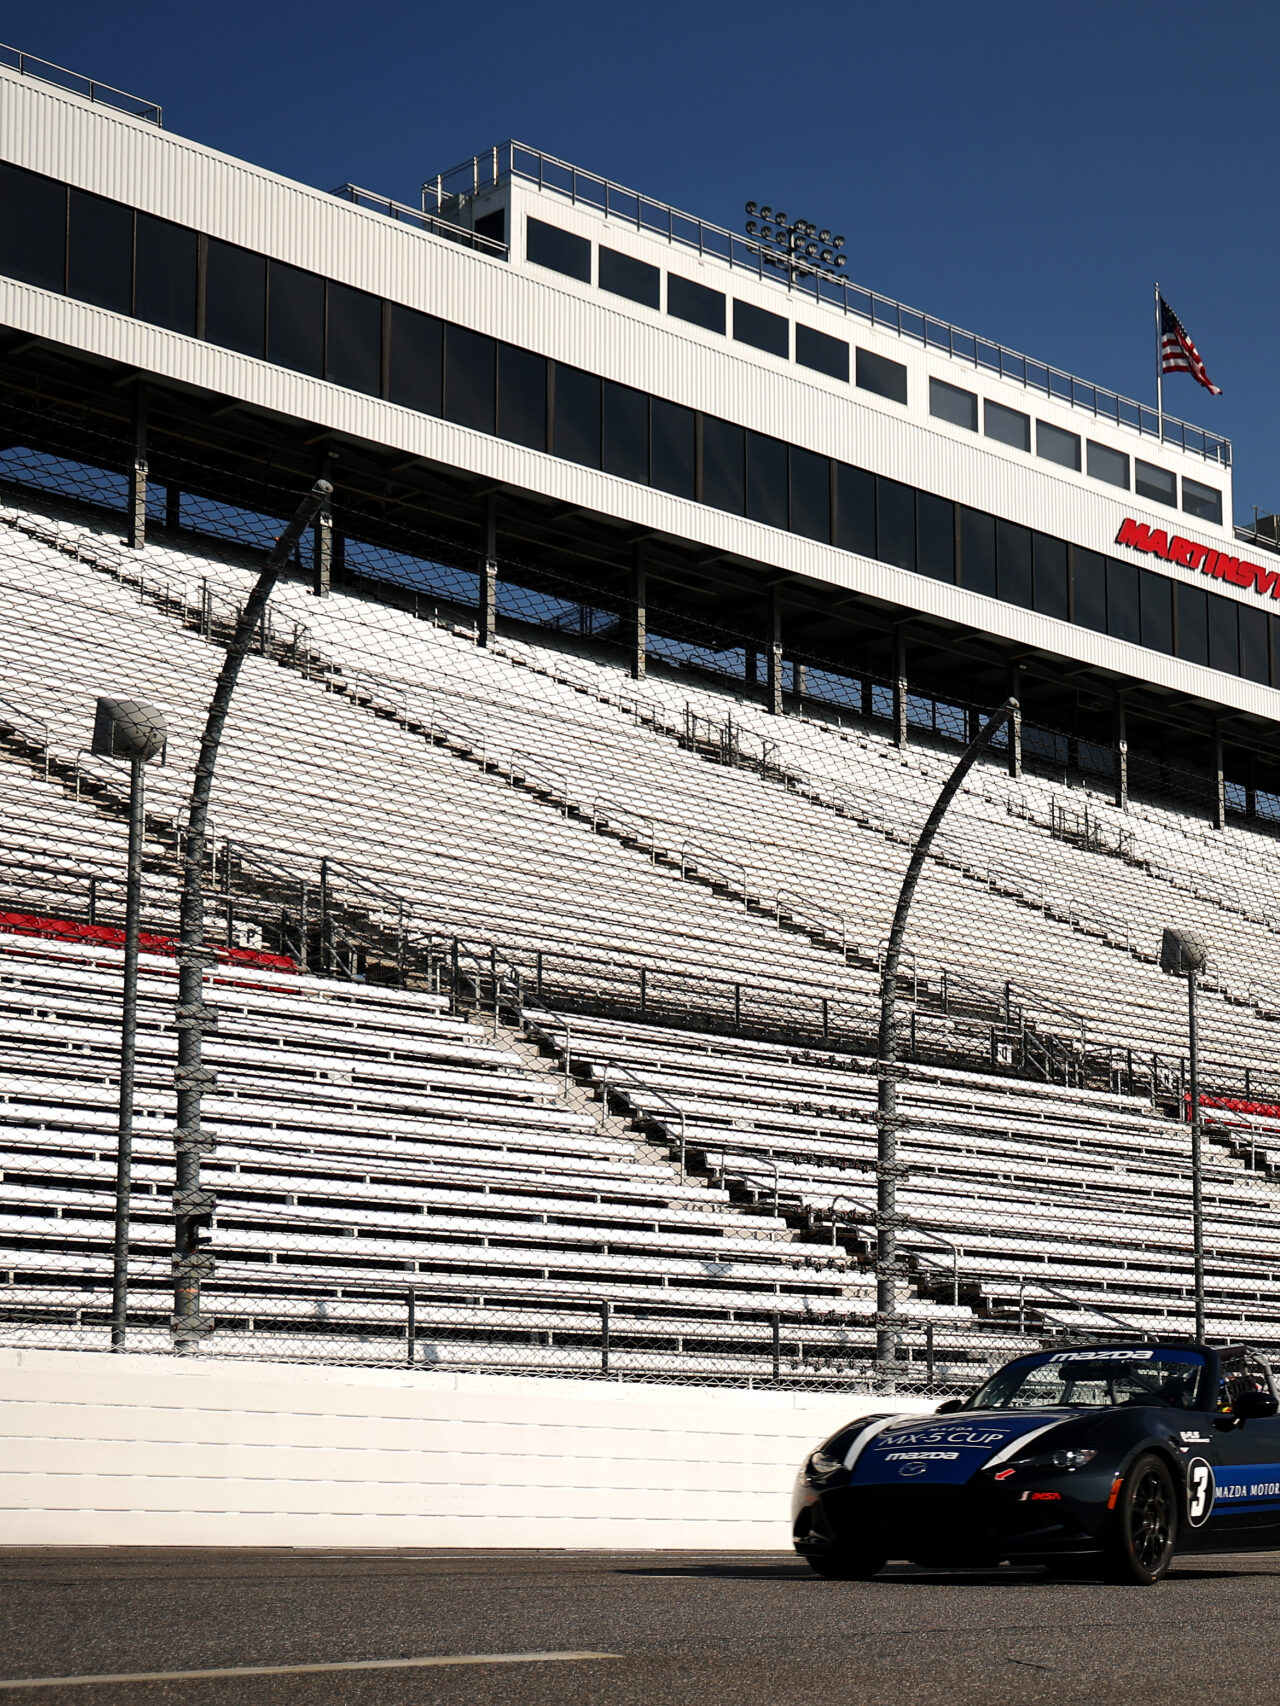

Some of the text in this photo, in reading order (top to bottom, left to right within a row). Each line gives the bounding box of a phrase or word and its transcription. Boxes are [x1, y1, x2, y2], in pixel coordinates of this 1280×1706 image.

[878, 1432, 1005, 1447] MX-5 CUP
[1190, 1466, 1209, 1517] 3
[1216, 1484, 1247, 1498] MAZDA
